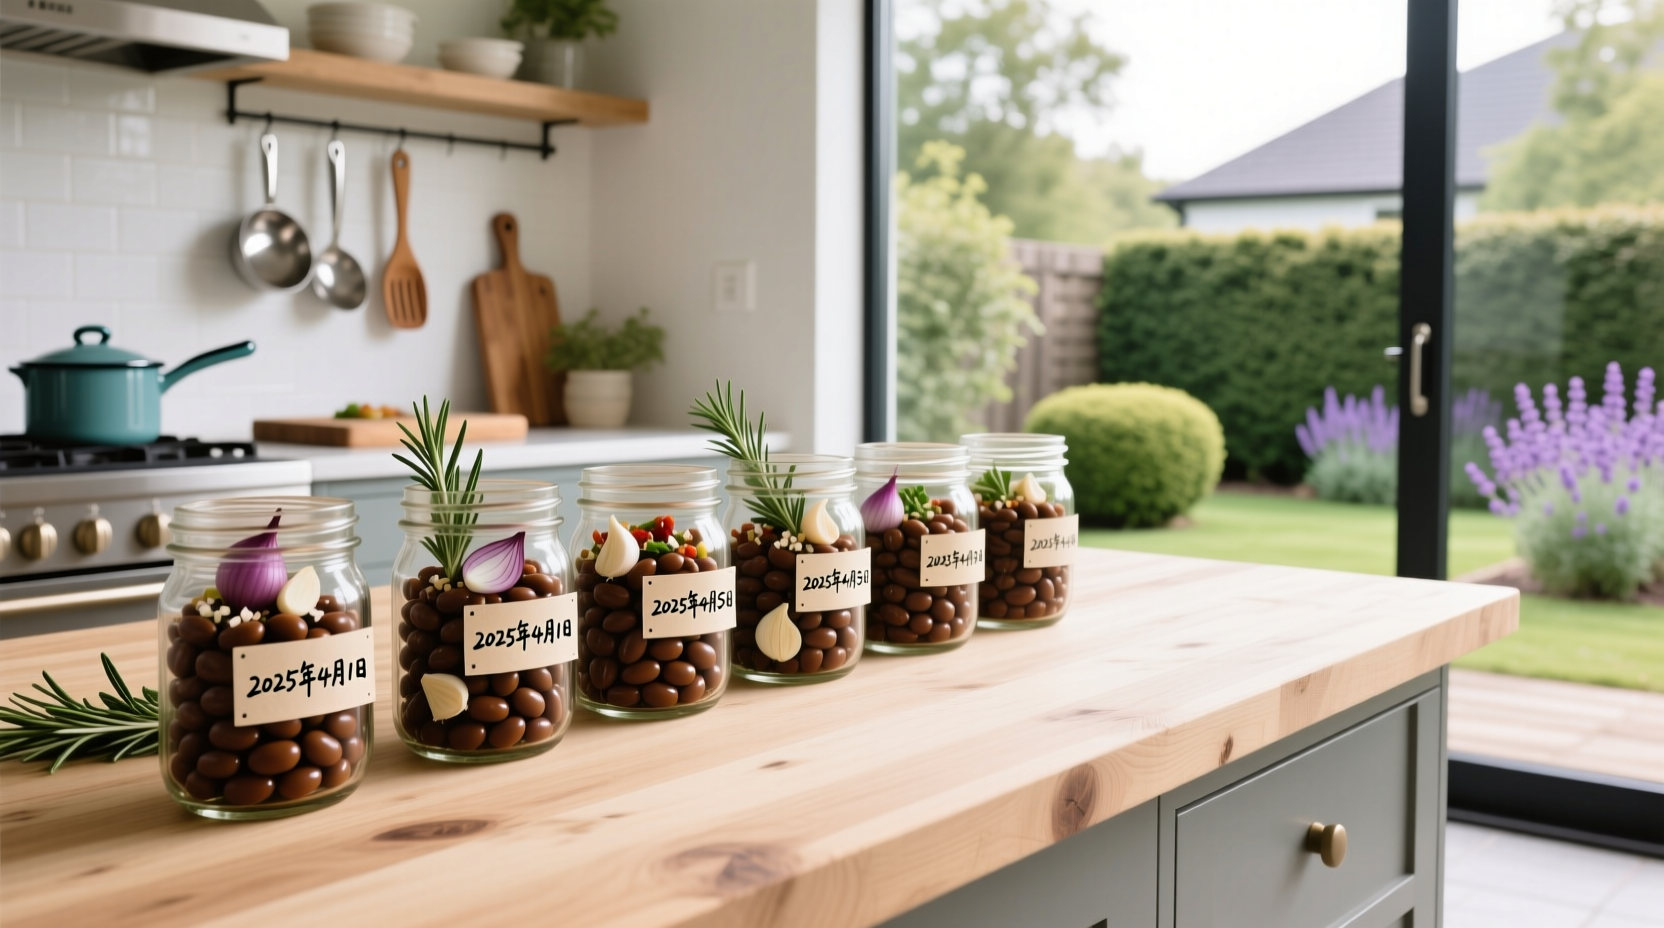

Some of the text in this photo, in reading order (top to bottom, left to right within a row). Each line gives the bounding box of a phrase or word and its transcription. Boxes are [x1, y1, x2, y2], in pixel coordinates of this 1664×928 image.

[651, 590, 733, 619] 2025年4月5日
[473, 618, 572, 652] 2025年4月1日
[247, 657, 367, 698] 2025年4月1日
